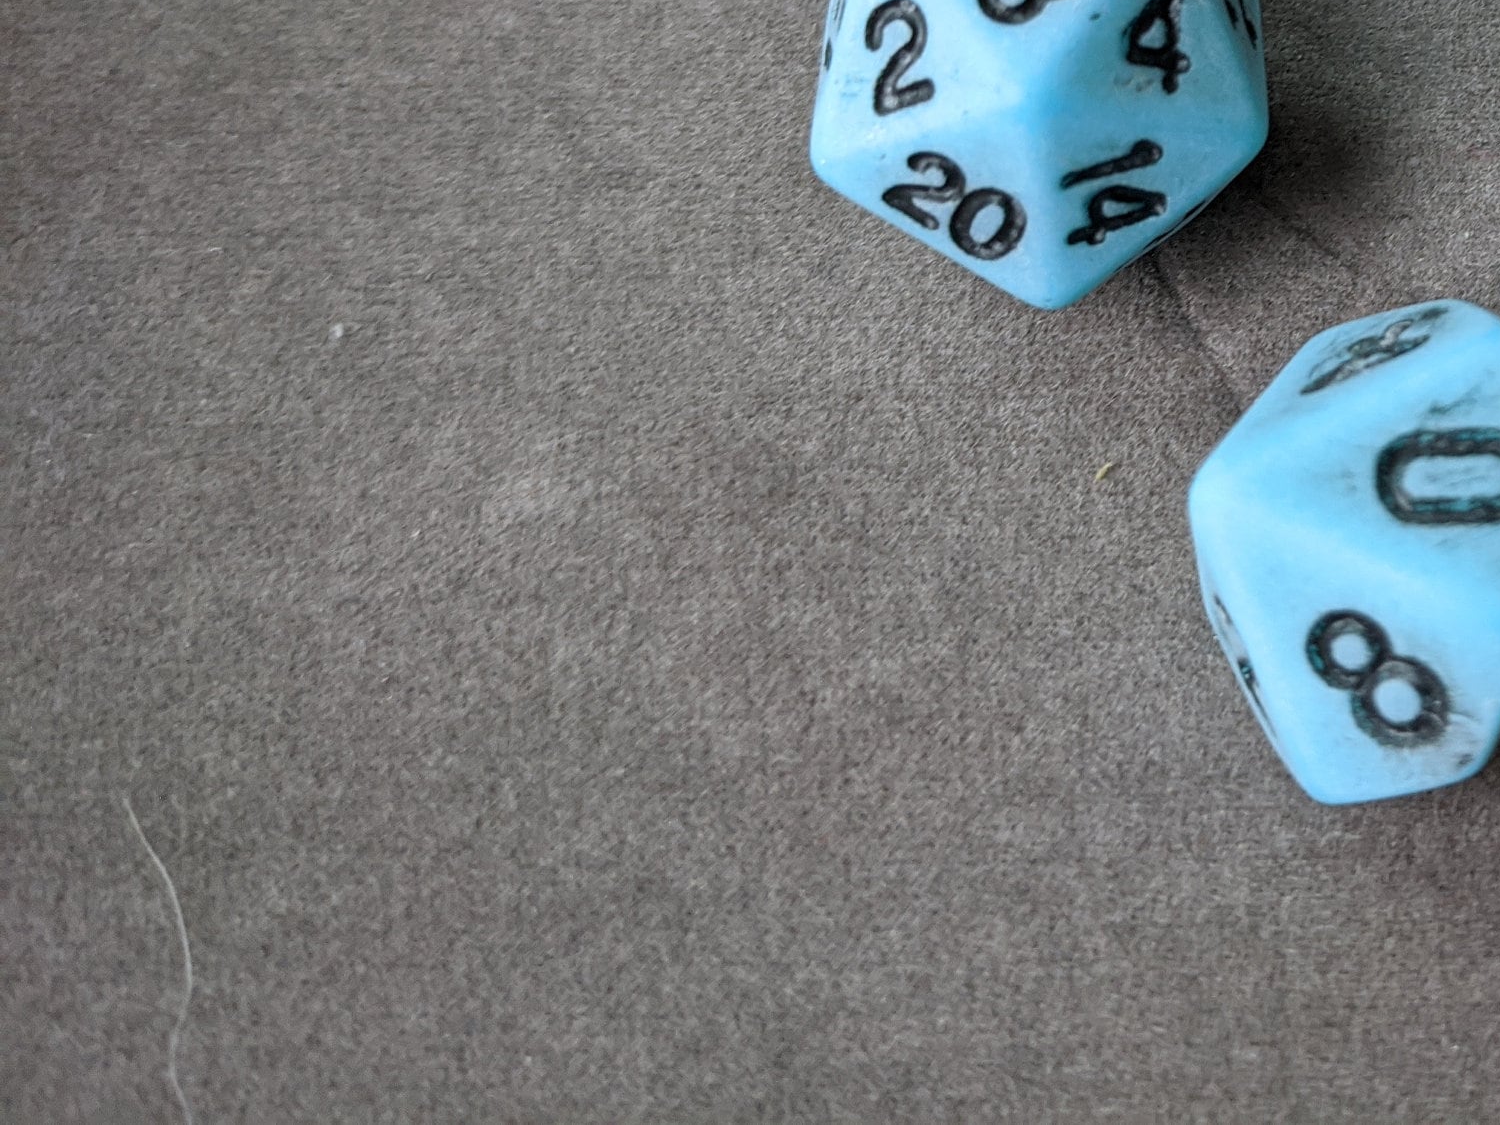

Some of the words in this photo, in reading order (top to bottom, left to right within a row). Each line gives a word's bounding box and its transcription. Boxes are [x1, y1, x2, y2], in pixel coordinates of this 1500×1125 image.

[881, 150, 1028, 261] 20
[1060, 138, 1167, 246] 14
[1305, 608, 1452, 749] 8
